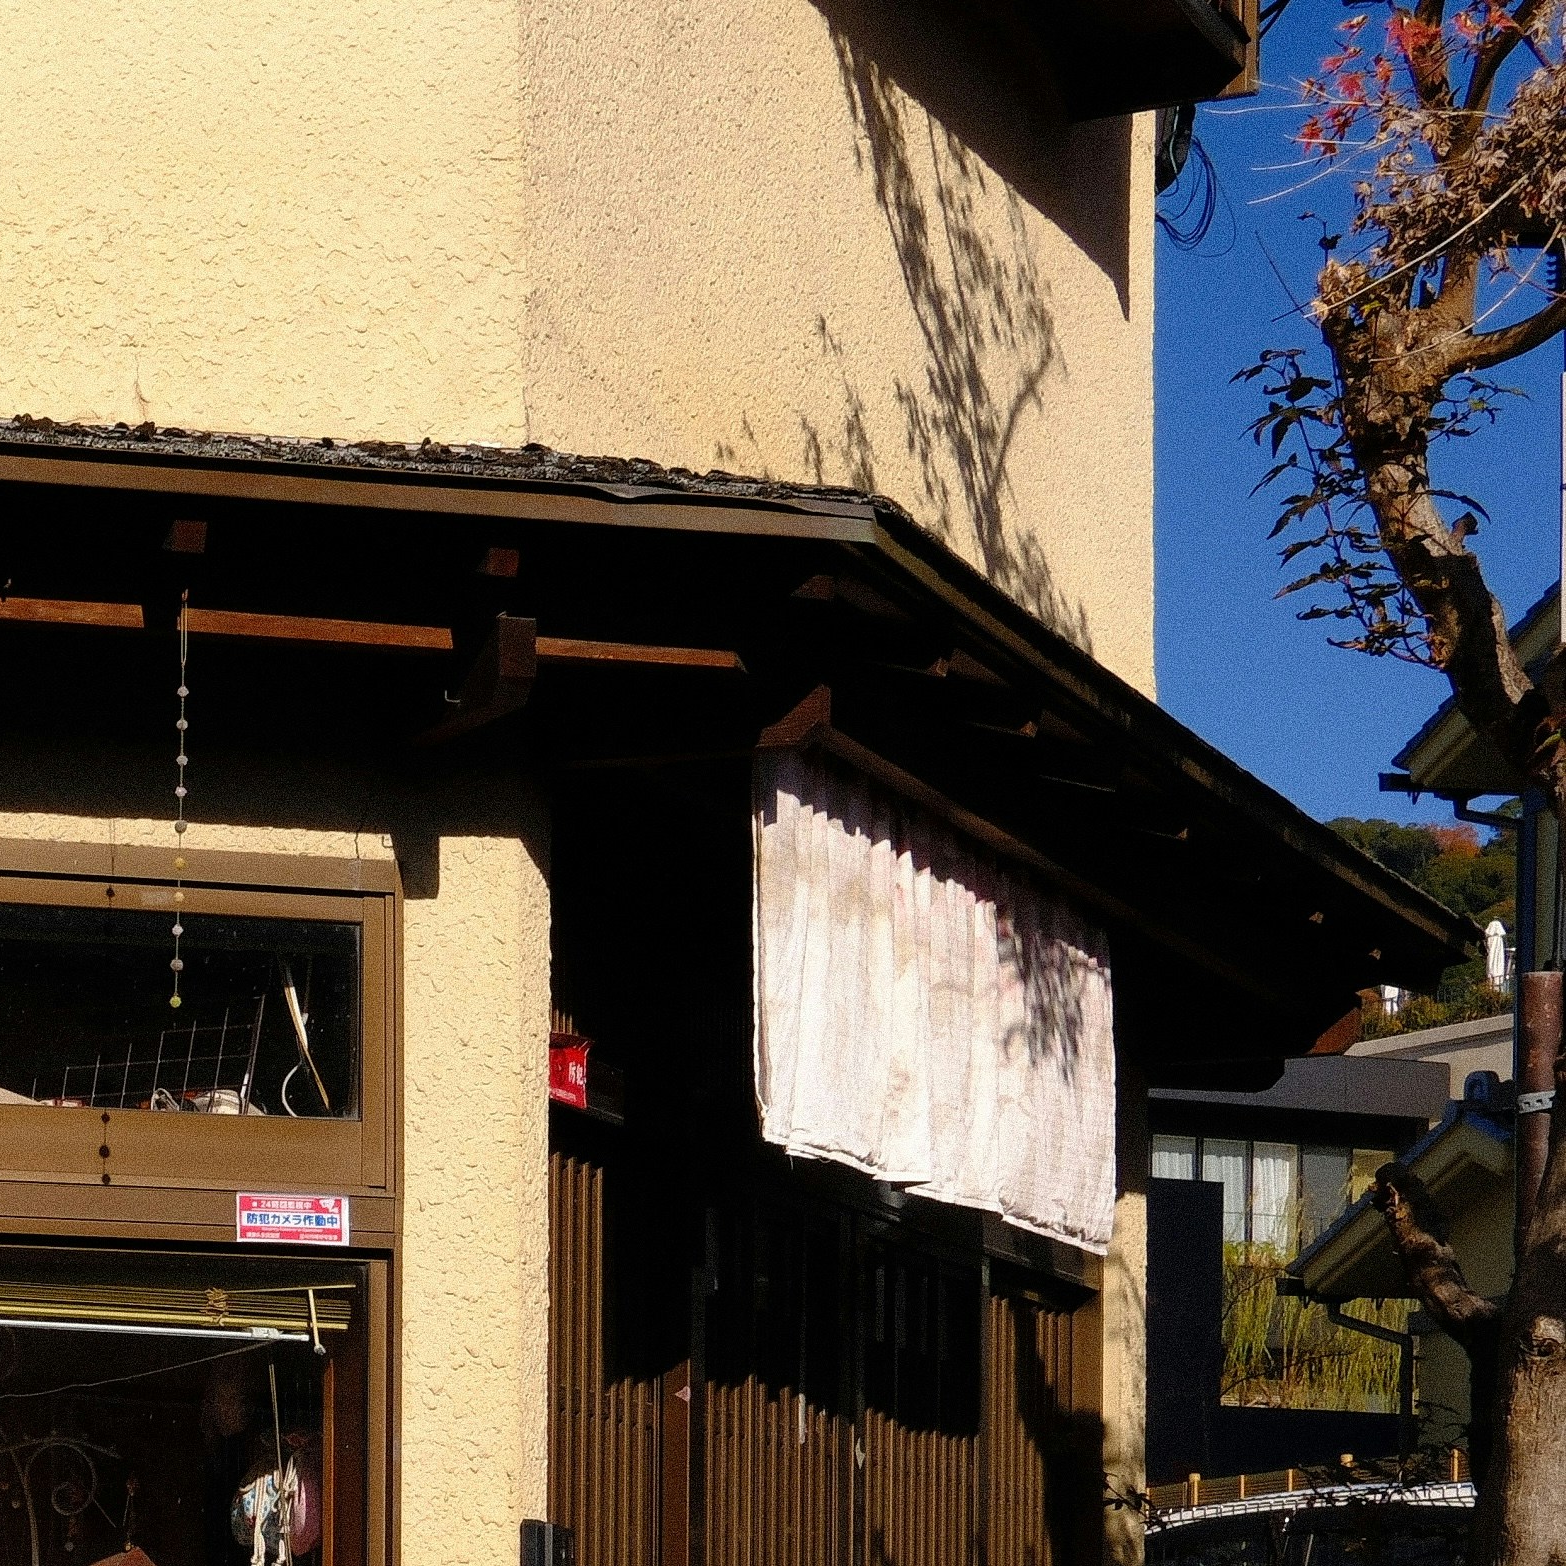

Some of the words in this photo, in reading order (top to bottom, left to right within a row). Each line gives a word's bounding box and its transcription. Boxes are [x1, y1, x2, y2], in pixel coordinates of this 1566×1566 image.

[246, 1213, 338, 1227] 防犯カメラ作動中
